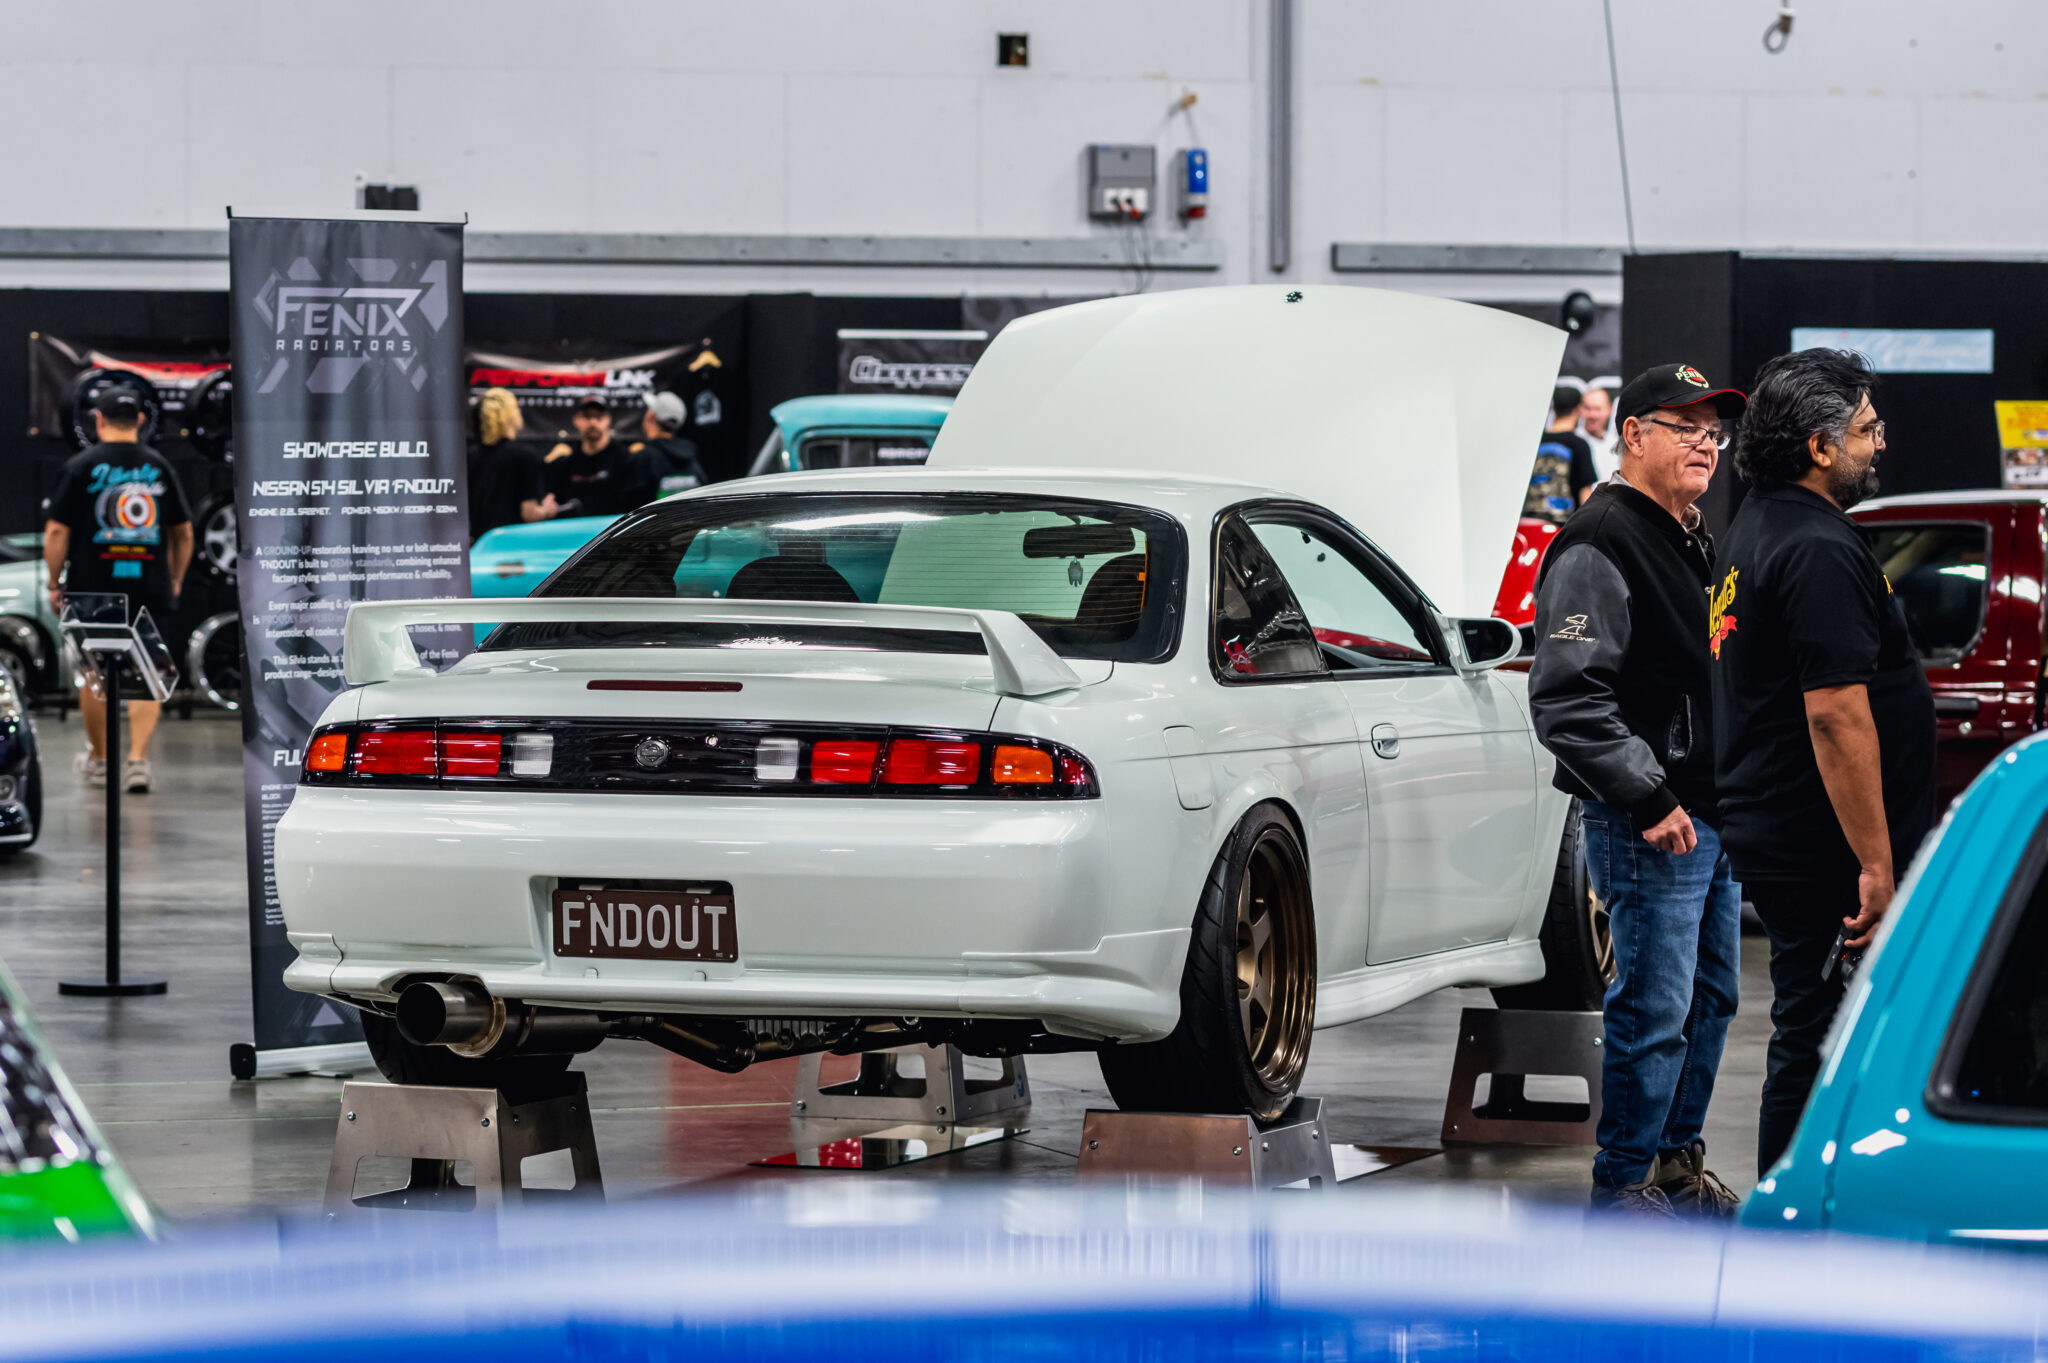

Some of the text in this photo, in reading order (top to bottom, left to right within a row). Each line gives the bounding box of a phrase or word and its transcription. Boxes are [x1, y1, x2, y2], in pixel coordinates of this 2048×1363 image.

[276, 287, 422, 336] FENIX
[276, 340, 412, 351] RADIATORS
[283, 441, 430, 459] SHOWCASE BUILD.
[253, 481, 309, 497] NISSAN
[311, 480, 336, 496] S14
[255, 546, 263, 556] A
[264, 545, 312, 556] GROUND-UP
[312, 545, 351, 555] restoration
[352, 544, 380, 555] leaving
[392, 545, 405, 553] nut
[415, 543, 429, 552] bolt
[298, 559, 304, 569] is
[305, 559, 320, 568] built
[321, 560, 329, 568] to
[396, 556, 432, 567] combining
[433, 556, 461, 565] enhanced
[272, 574, 298, 584] factory
[298, 572, 320, 584] styling
[321, 572, 338, 581] with
[338, 572, 366, 581] serious
[367, 571, 414, 582] performance
[415, 570, 421, 579] &
[268, 601, 289, 611] Every
[290, 600, 310, 611] major
[310, 600, 335, 610] cooling
[336, 600, 342, 608] &
[253, 615, 260, 624] is
[306, 627, 315, 636] oil
[273, 655, 289, 665] This
[289, 654, 307, 665] Silvia
[307, 654, 331, 663] stands
[420, 649, 459, 659] of the Fenix
[265, 670, 293, 681] product
[562, 902, 728, 951] FNDOUT
